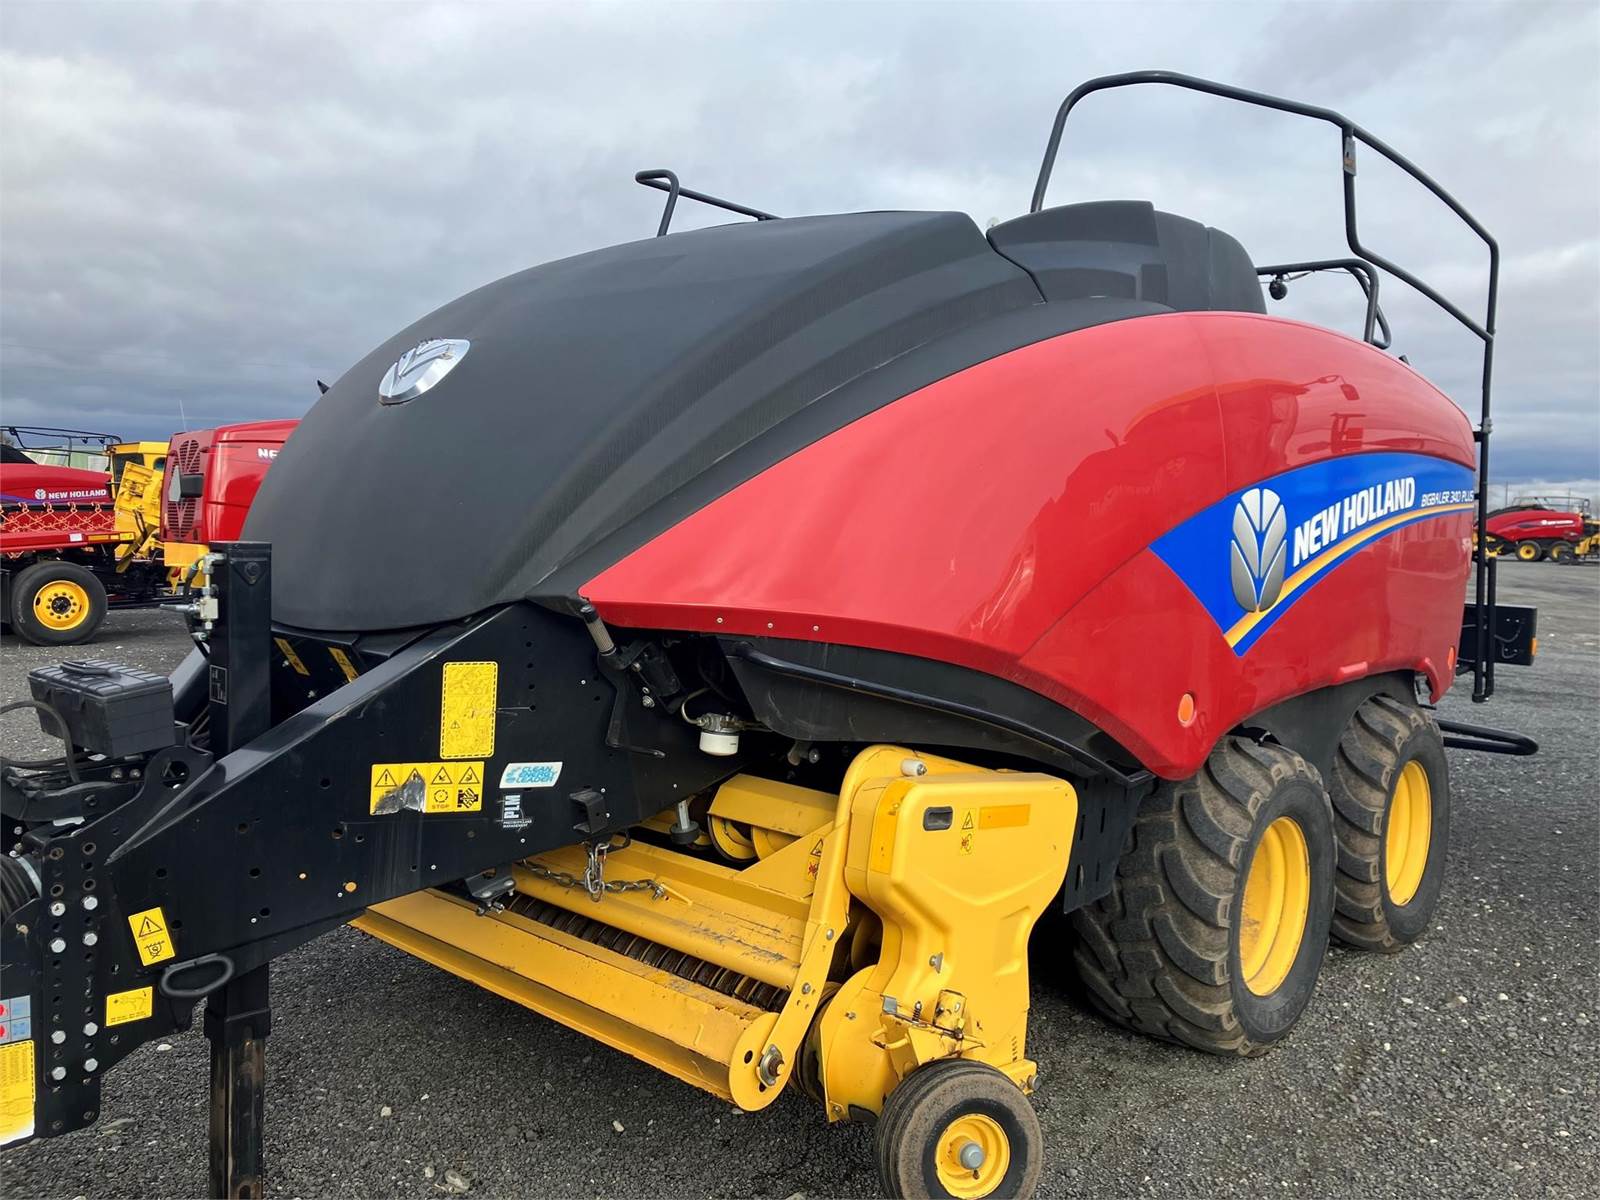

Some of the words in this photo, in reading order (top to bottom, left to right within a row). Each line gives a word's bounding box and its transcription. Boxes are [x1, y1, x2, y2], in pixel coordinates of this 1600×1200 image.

[257, 448, 280, 459] NE
[69, 489, 107, 498] HOLLAND
[1293, 502, 1341, 567] NEW
[1343, 477, 1415, 534] HOLLAND
